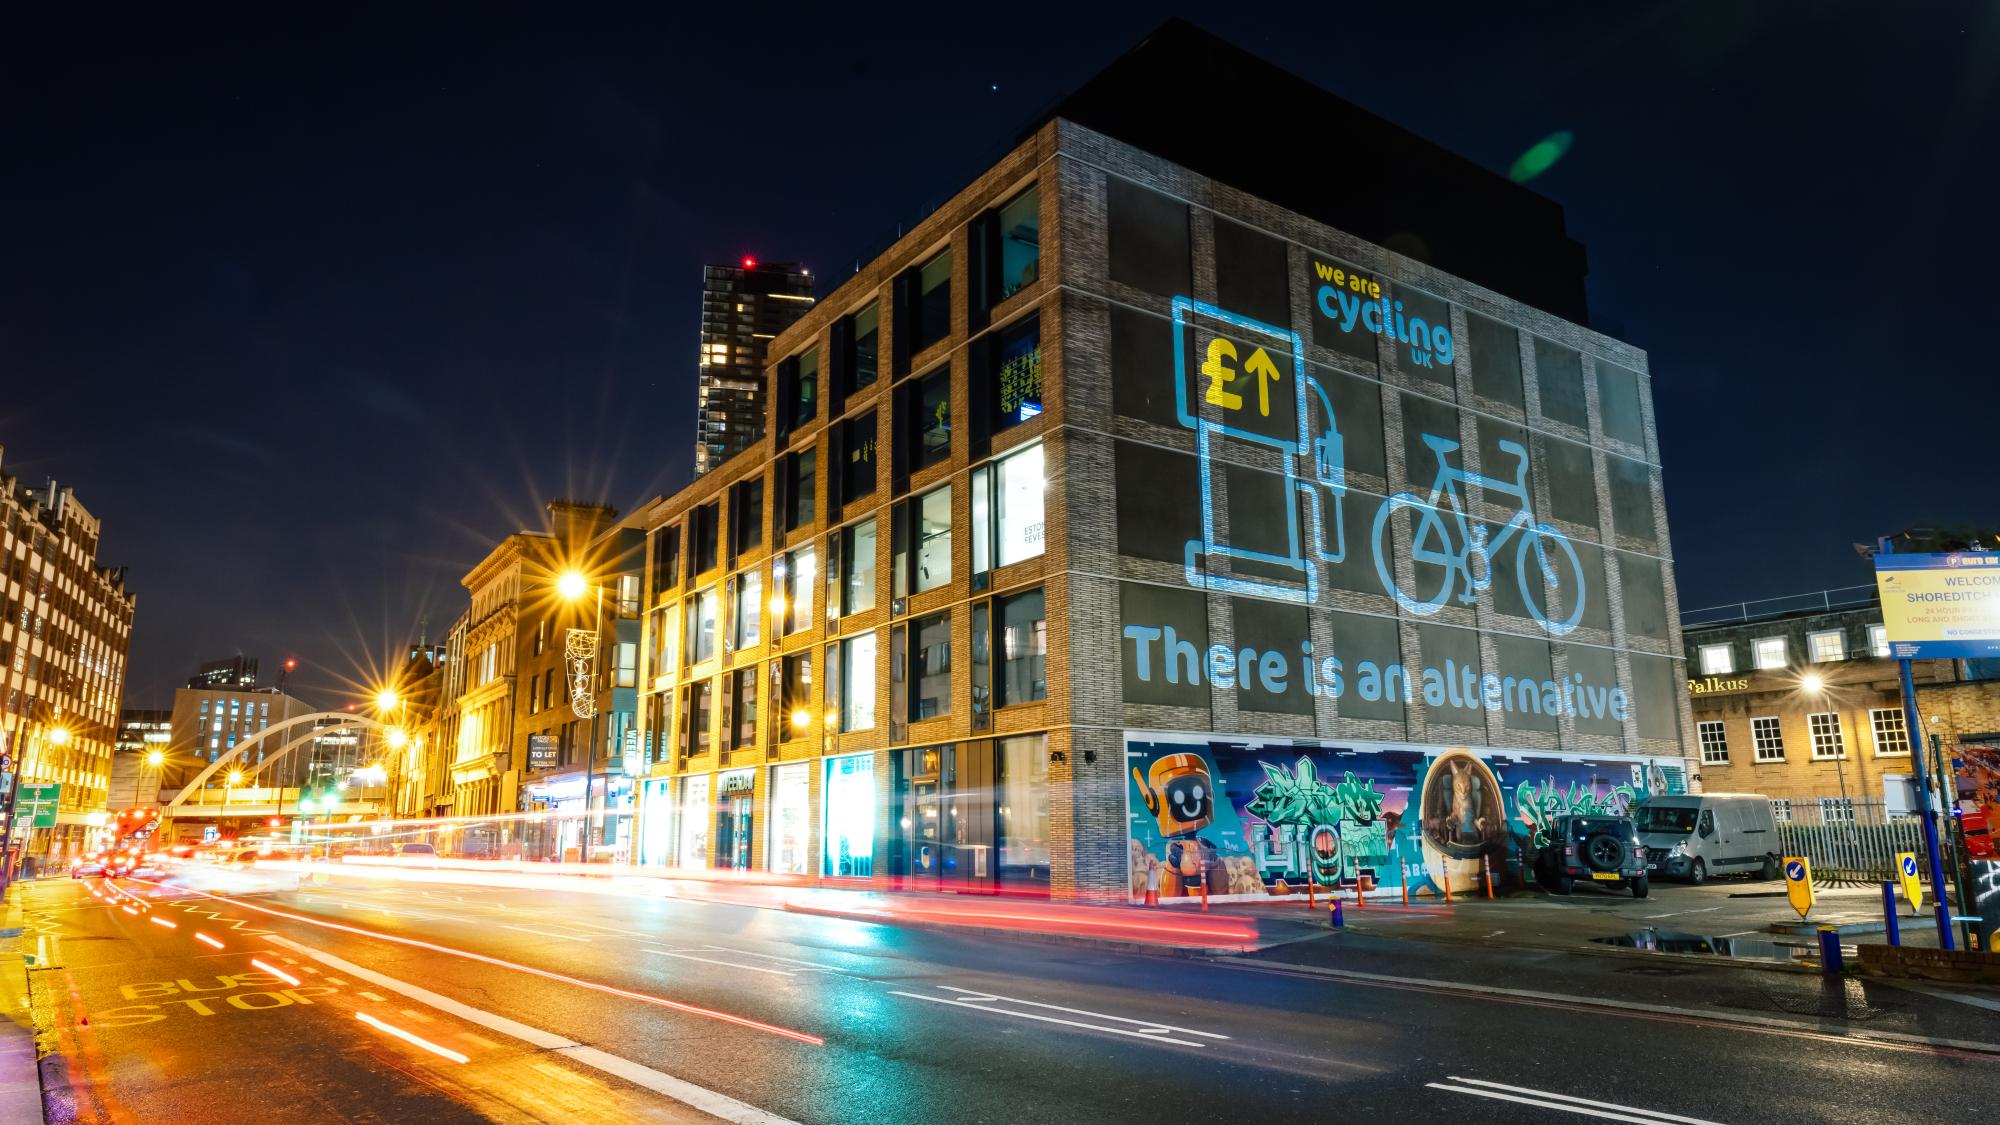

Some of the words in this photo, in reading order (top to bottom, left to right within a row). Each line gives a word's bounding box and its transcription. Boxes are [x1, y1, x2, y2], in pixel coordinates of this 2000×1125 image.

[1315, 261, 1345, 286] we
[1349, 274, 1381, 299] are
[1317, 285, 1454, 366] cycling
[1411, 346, 1433, 369] UK
[1906, 591, 1991, 603] SHOREDITCH
[1907, 616, 1930, 624] LONG
[1123, 624, 1289, 694] There
[1301, 640, 1345, 699] is
[1356, 660, 1412, 703] an
[1423, 658, 1628, 722] alternative
[1687, 677, 1749, 694] Falkus
[119, 972, 285, 1000] BUS
[94, 987, 339, 1028] STOP
